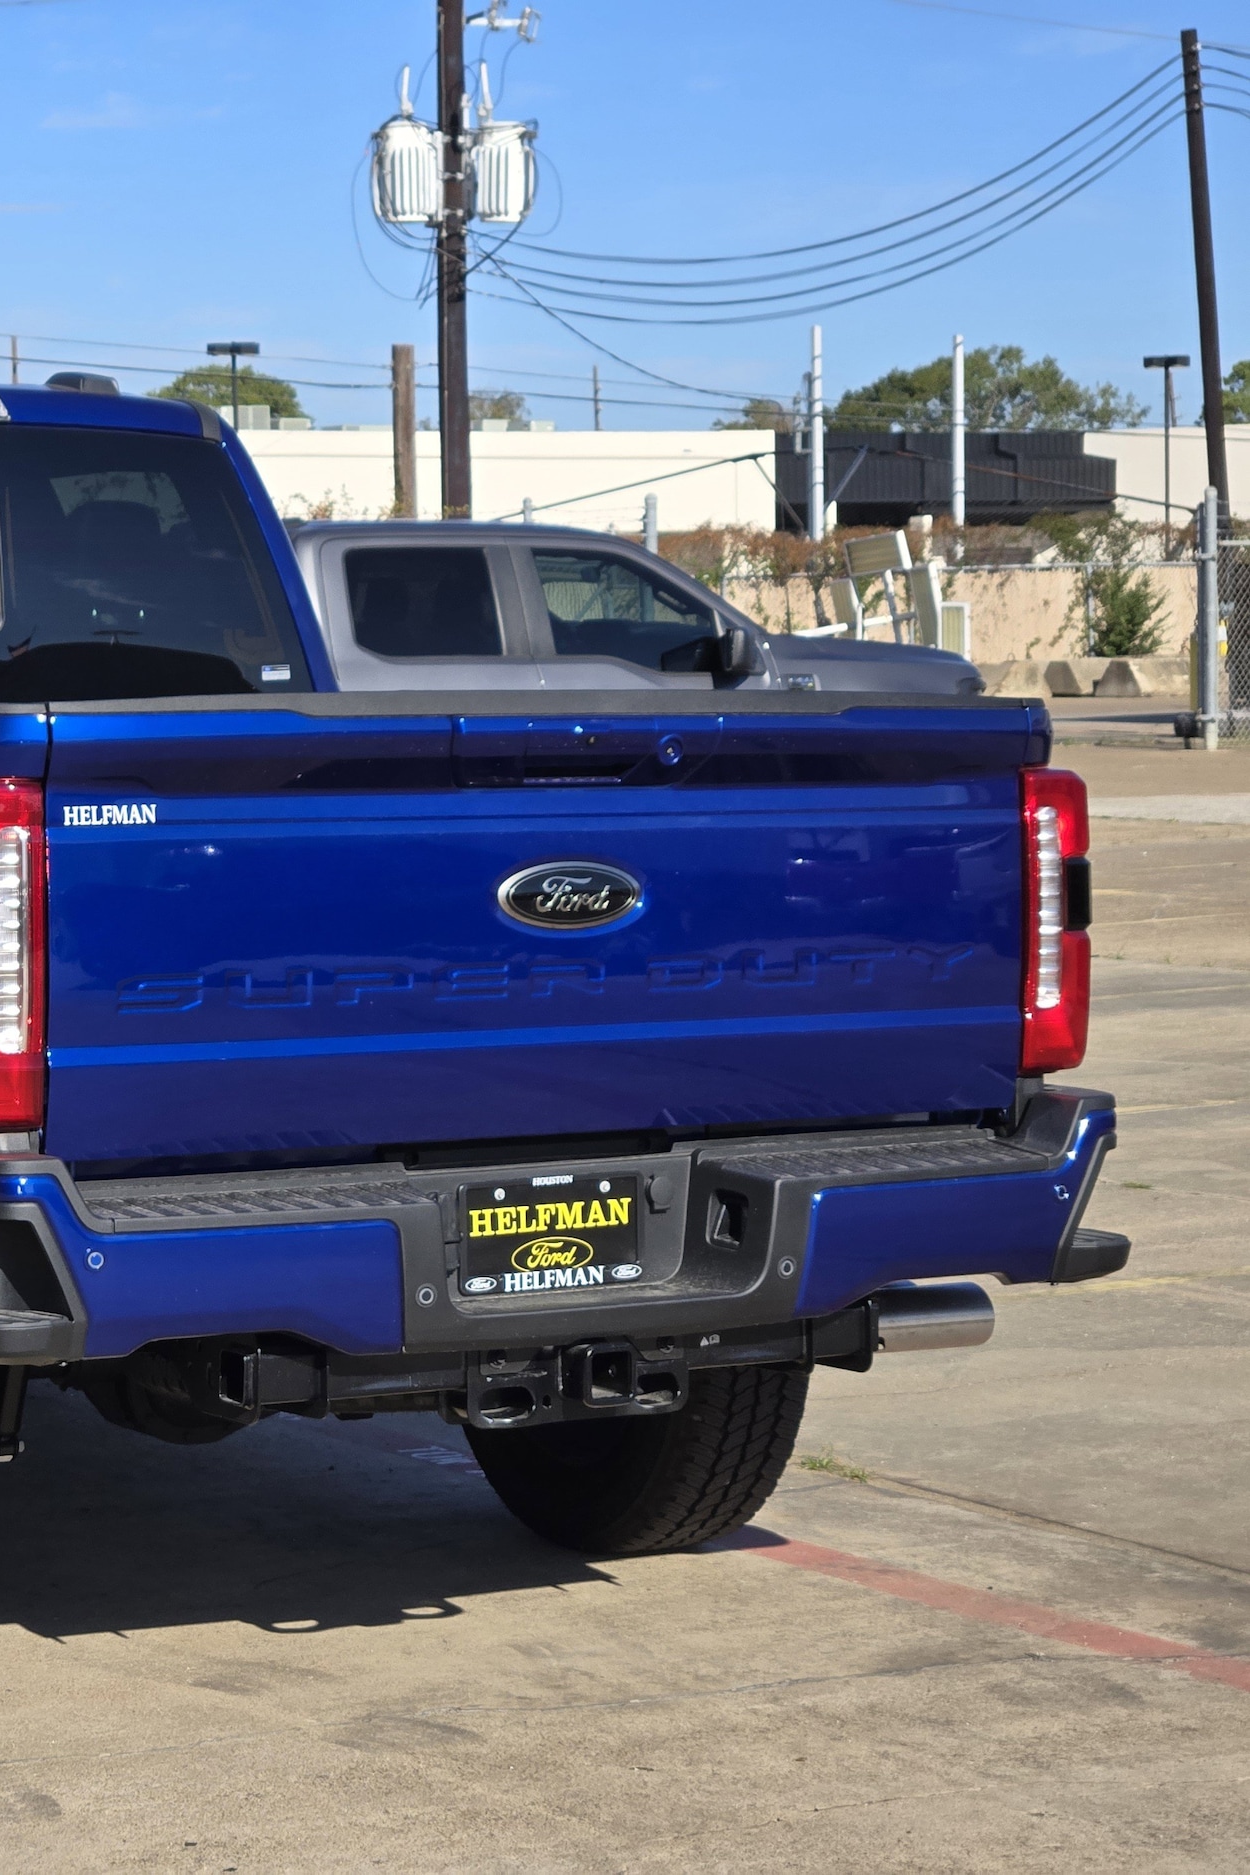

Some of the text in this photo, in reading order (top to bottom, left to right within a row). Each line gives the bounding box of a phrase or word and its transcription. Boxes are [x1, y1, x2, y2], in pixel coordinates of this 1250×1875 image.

[63, 804, 157, 826] HELFMAN
[535, 875, 611, 912] Ford
[116, 945, 976, 1016] SUPER DUTY
[532, 1175, 574, 1187] HOUSTON
[469, 1197, 632, 1237] HELFMAN
[526, 1241, 577, 1268] Ford
[503, 1265, 606, 1293] HELFMAN
